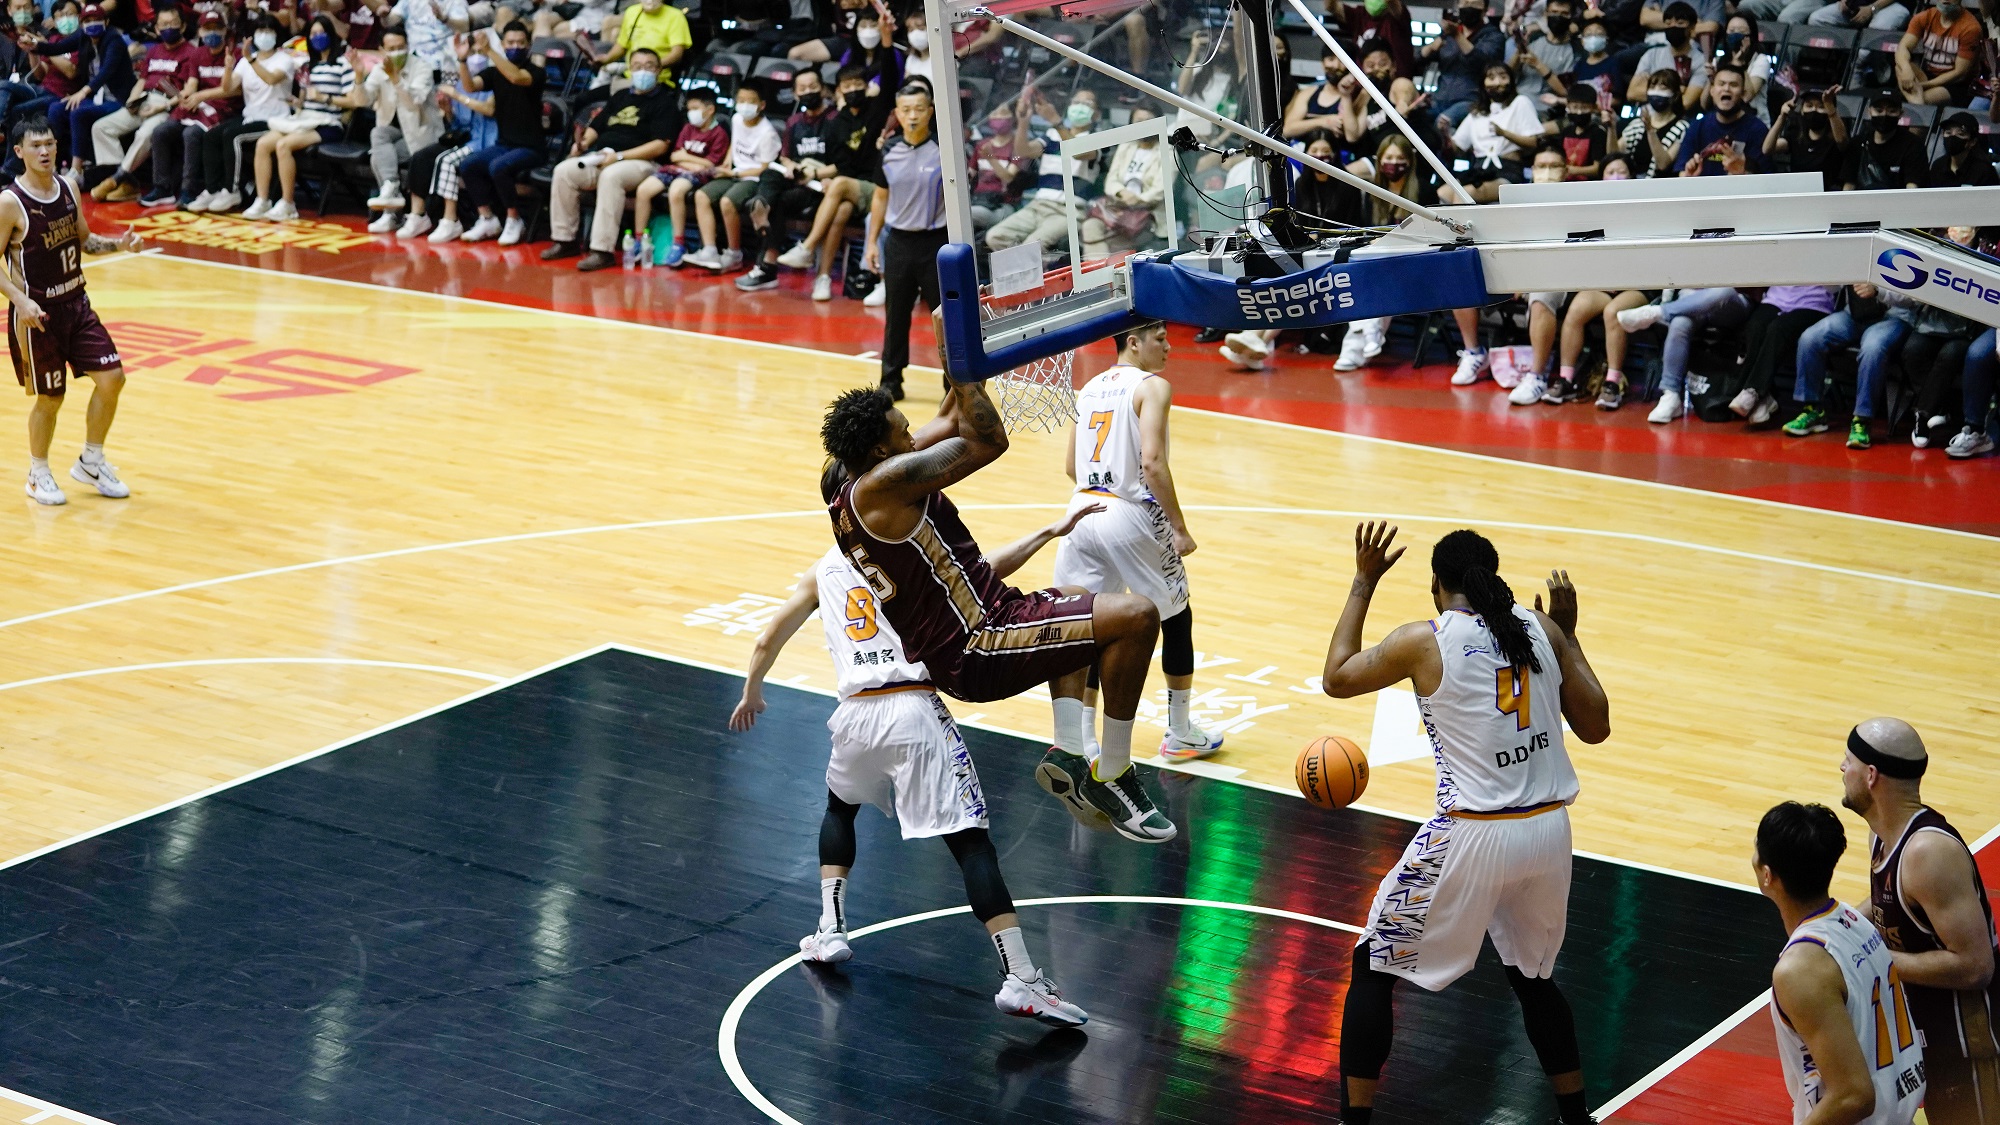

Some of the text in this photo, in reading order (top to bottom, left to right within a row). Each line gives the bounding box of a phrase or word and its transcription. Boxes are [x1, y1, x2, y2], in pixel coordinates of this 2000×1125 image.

[41, 224, 79, 249] HAWK
[60, 245, 77, 274] 12
[1236, 272, 1352, 305] Schelde
[1932, 267, 2000, 305] Sche
[1241, 291, 1355, 323] Sports
[45, 370, 62, 389] 12
[1088, 410, 1114, 462] 7
[845, 543, 898, 604] 5
[844, 586, 880, 642] 9
[1495, 665, 1530, 732] 4
[1496, 731, 1550, 768] D.DVIS
[1306, 756, 1322, 803] Wilson
[1871, 960, 1915, 1070] 11
